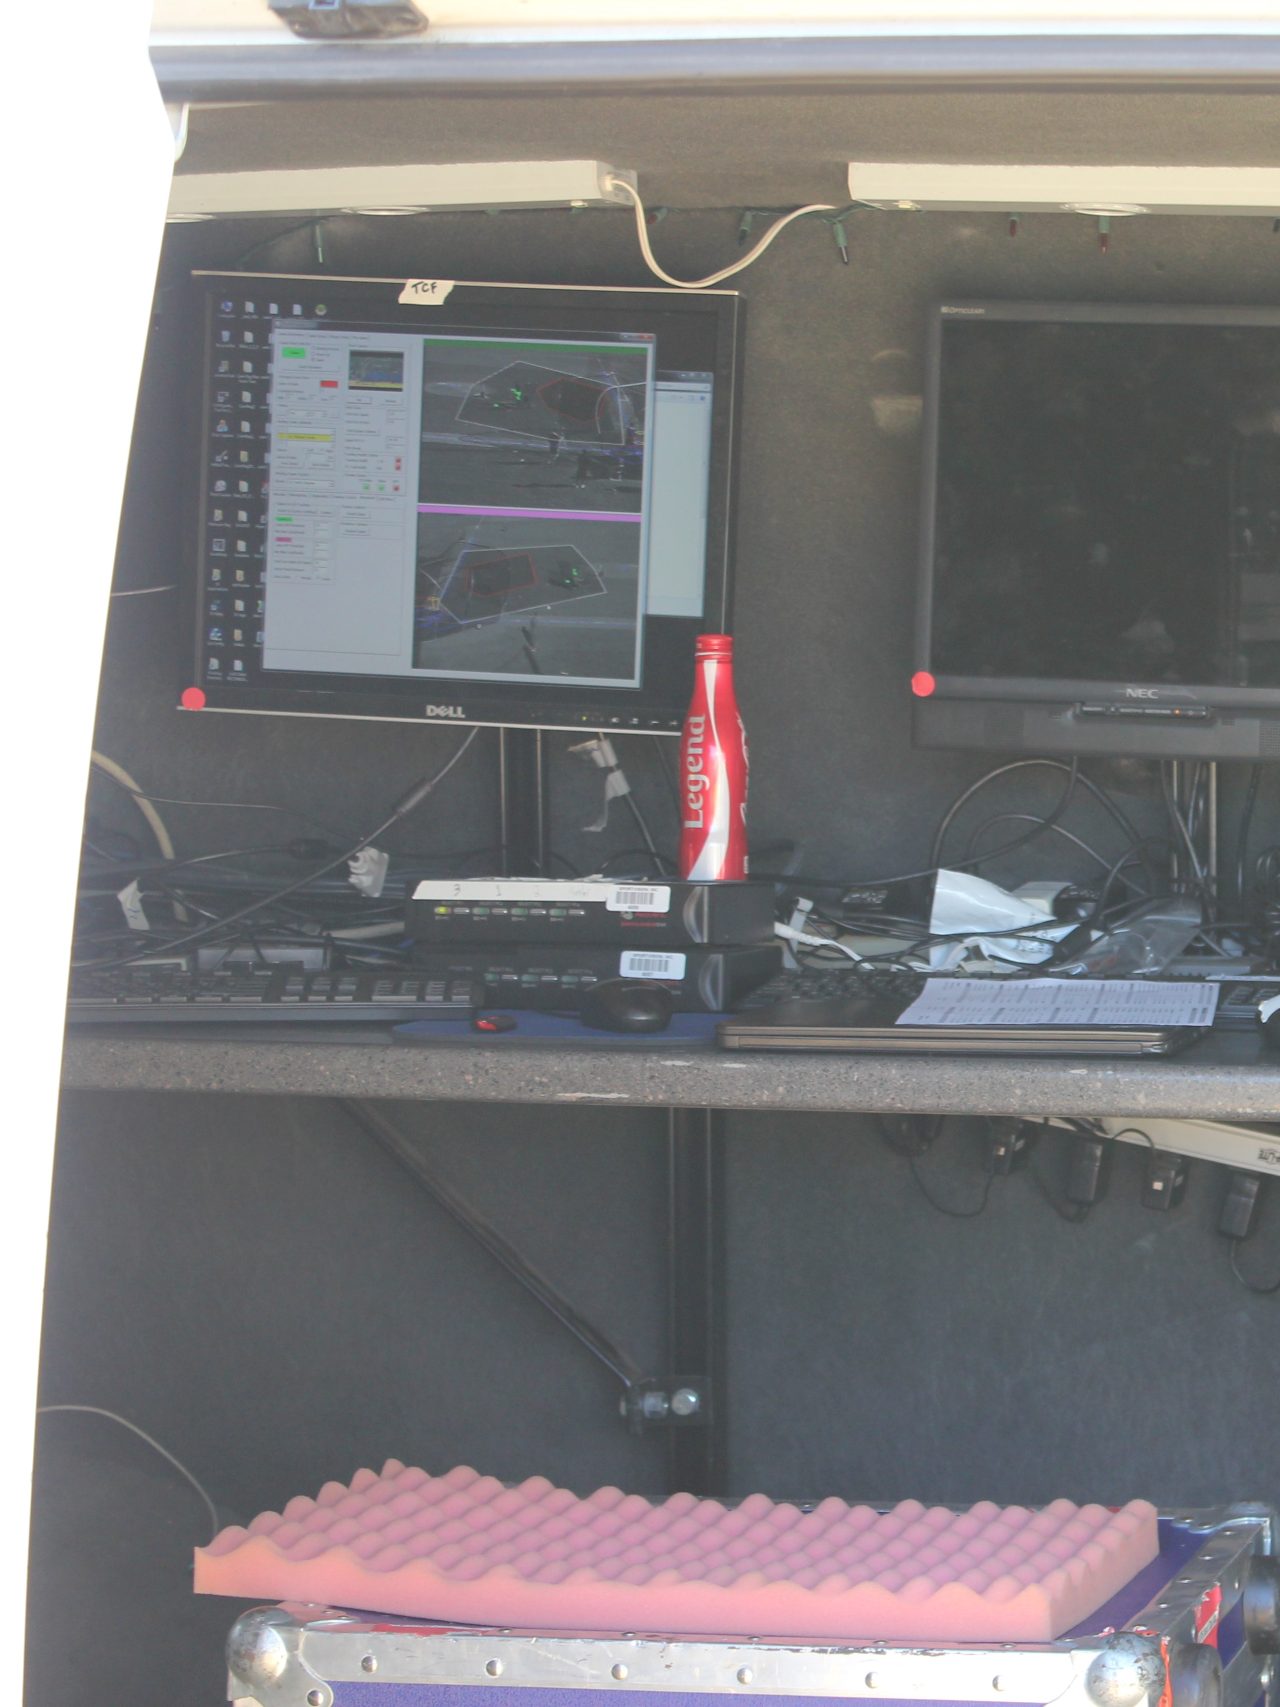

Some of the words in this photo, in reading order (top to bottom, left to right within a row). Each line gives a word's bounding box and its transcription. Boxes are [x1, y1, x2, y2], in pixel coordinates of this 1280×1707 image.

[411, 281, 437, 294] TCF
[1125, 688, 1159, 699] NEC
[426, 704, 466, 719] DELL
[684, 714, 711, 829] Legend
